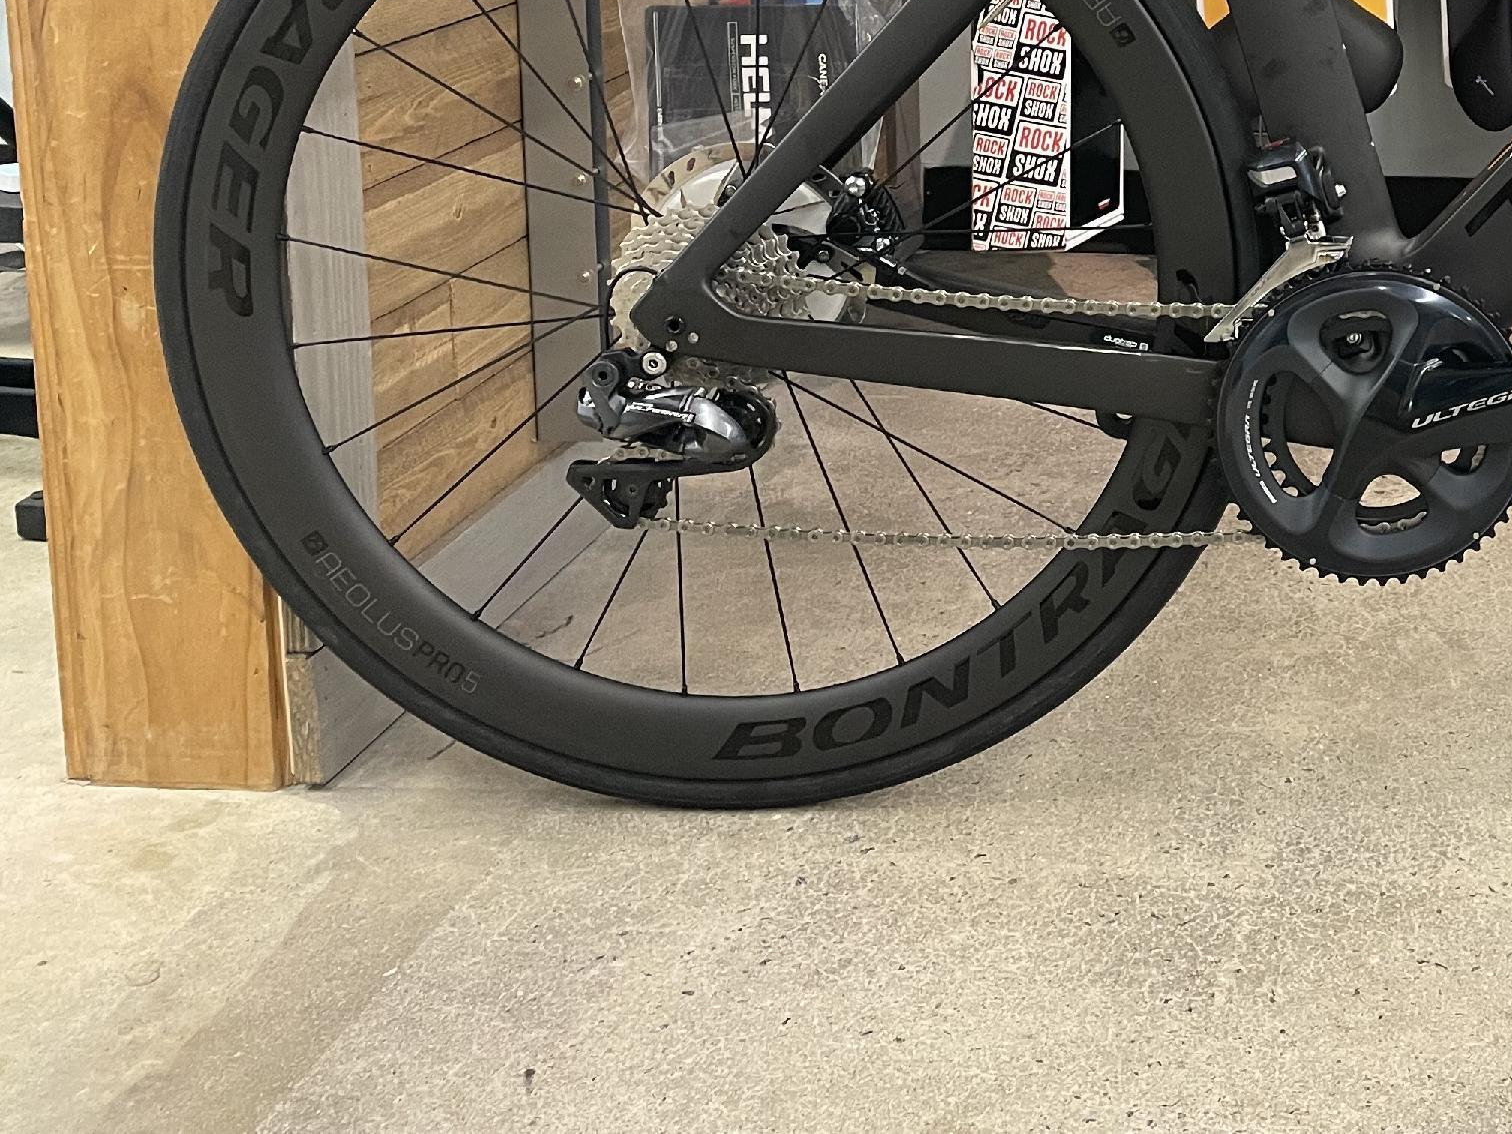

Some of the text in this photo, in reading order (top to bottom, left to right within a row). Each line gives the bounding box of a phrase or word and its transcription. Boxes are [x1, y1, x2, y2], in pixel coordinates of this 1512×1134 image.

[1025, 18, 1067, 47] ROCK
[1018, 46, 1065, 75] SHOX
[1028, 81, 1057, 100] ROCK
[1024, 100, 1055, 119] SHOX
[976, 137, 1006, 155] ROCK
[1019, 126, 1064, 153] ROCK
[973, 155, 1002, 175] SHOX
[1012, 153, 1059, 182] SHOX
[1003, 187, 1034, 205] ROCK
[1000, 204, 1030, 226] SHOX
[993, 231, 1023, 246] ROCK
